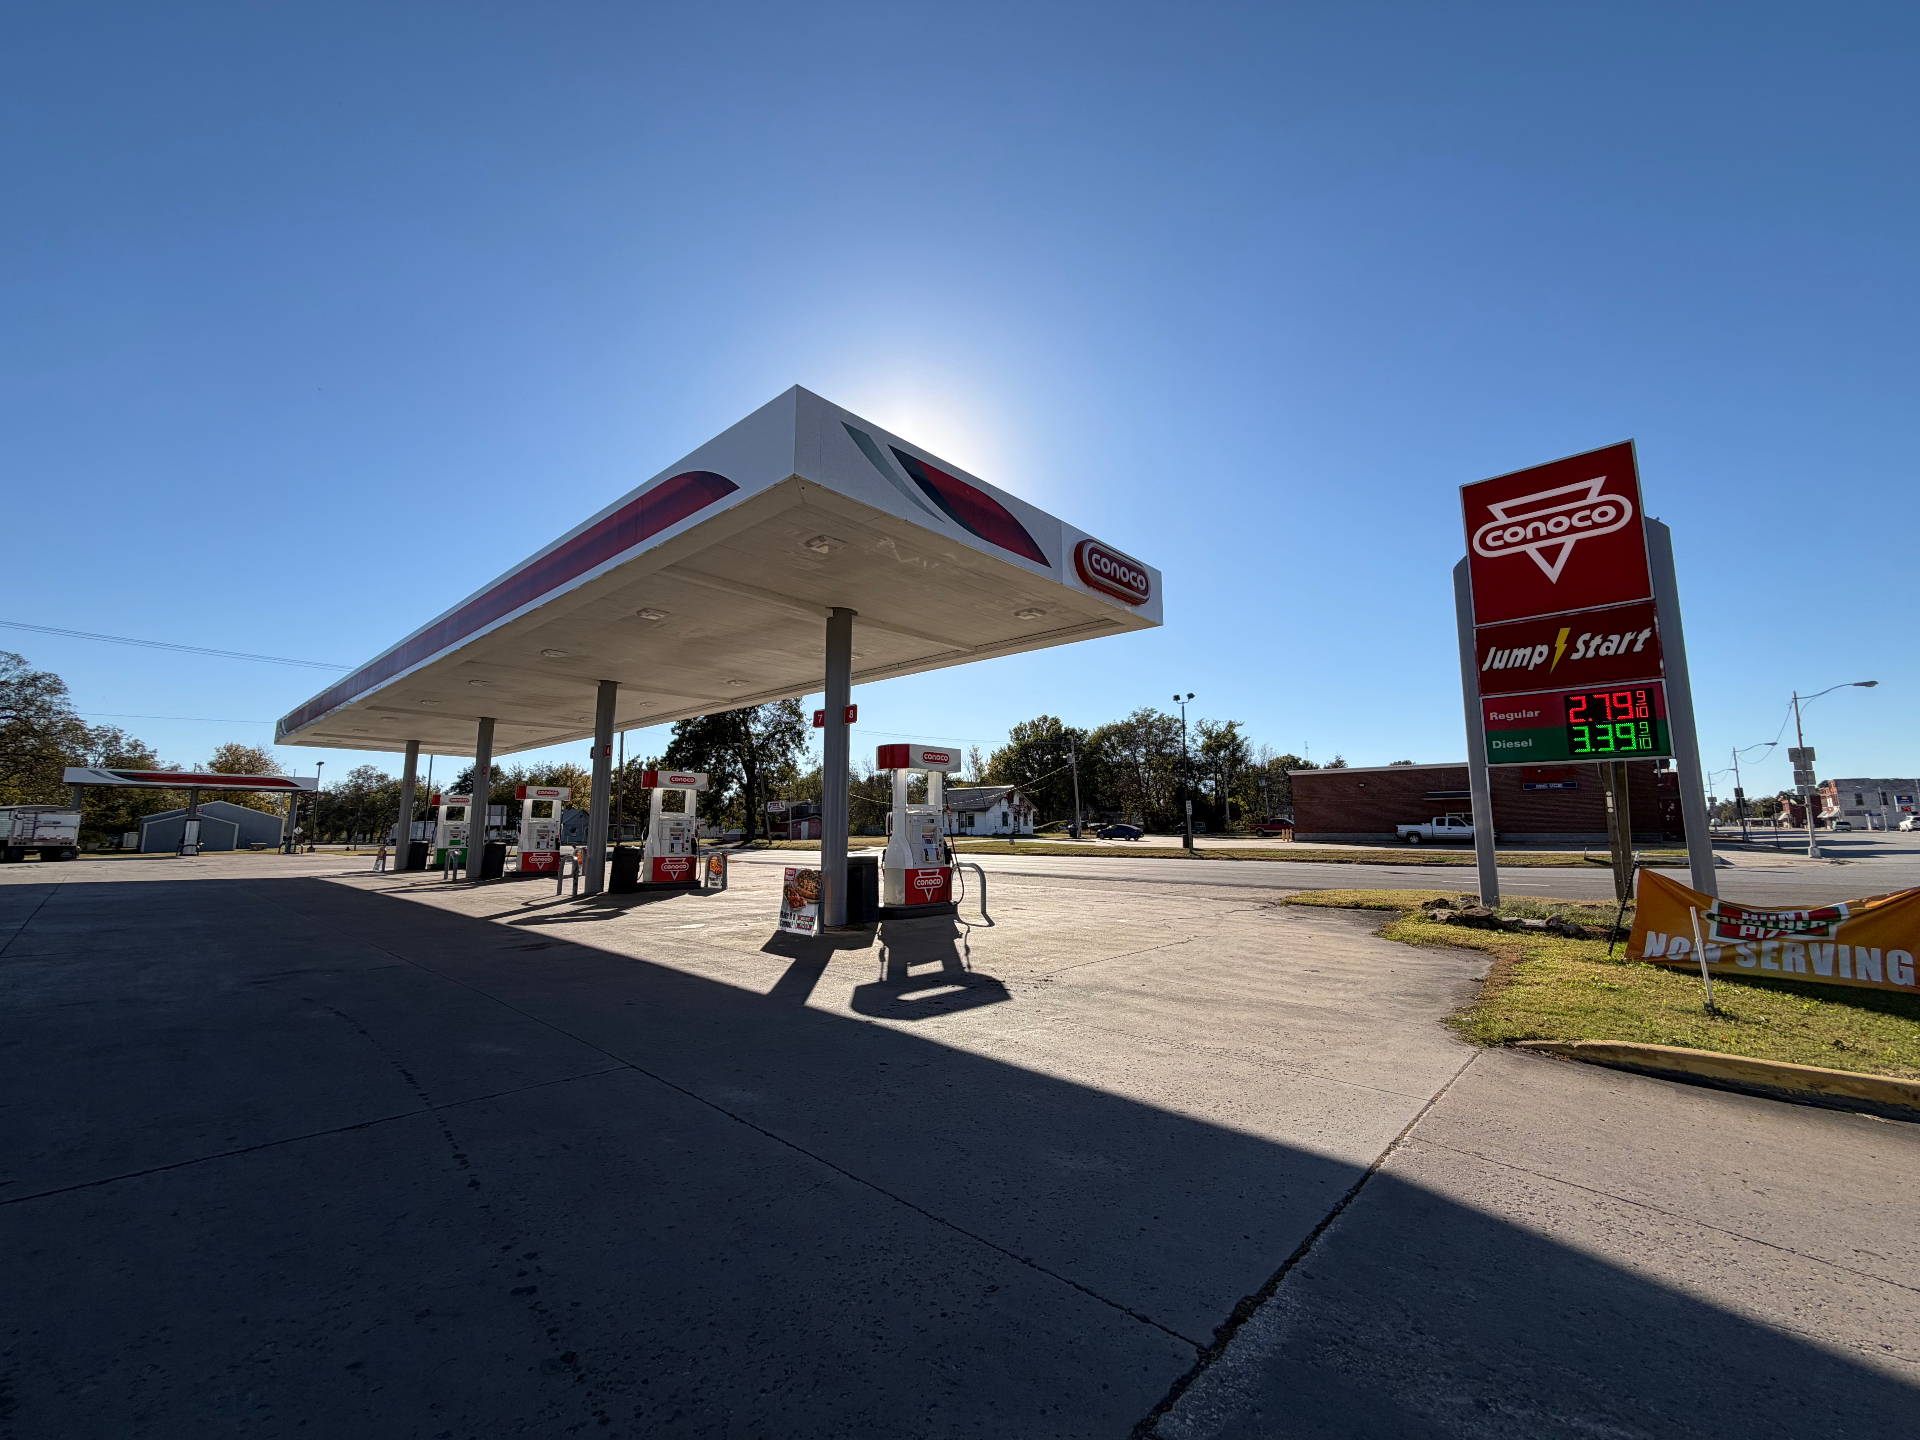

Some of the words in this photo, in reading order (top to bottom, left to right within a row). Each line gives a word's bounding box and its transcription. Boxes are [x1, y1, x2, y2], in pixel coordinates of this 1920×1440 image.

[1482, 644, 1549, 672] Jump
[1570, 627, 1652, 660] Start
[817, 714, 823, 724] 7
[848, 709, 854, 719] 8
[1489, 709, 1540, 722] Regular
[1569, 691, 1634, 723] 2.79
[1492, 738, 1533, 749] Diesel
[1572, 722, 1637, 753] 3.39
[1642, 931, 1721, 963] NOW
[1735, 940, 1916, 987] SERVING
